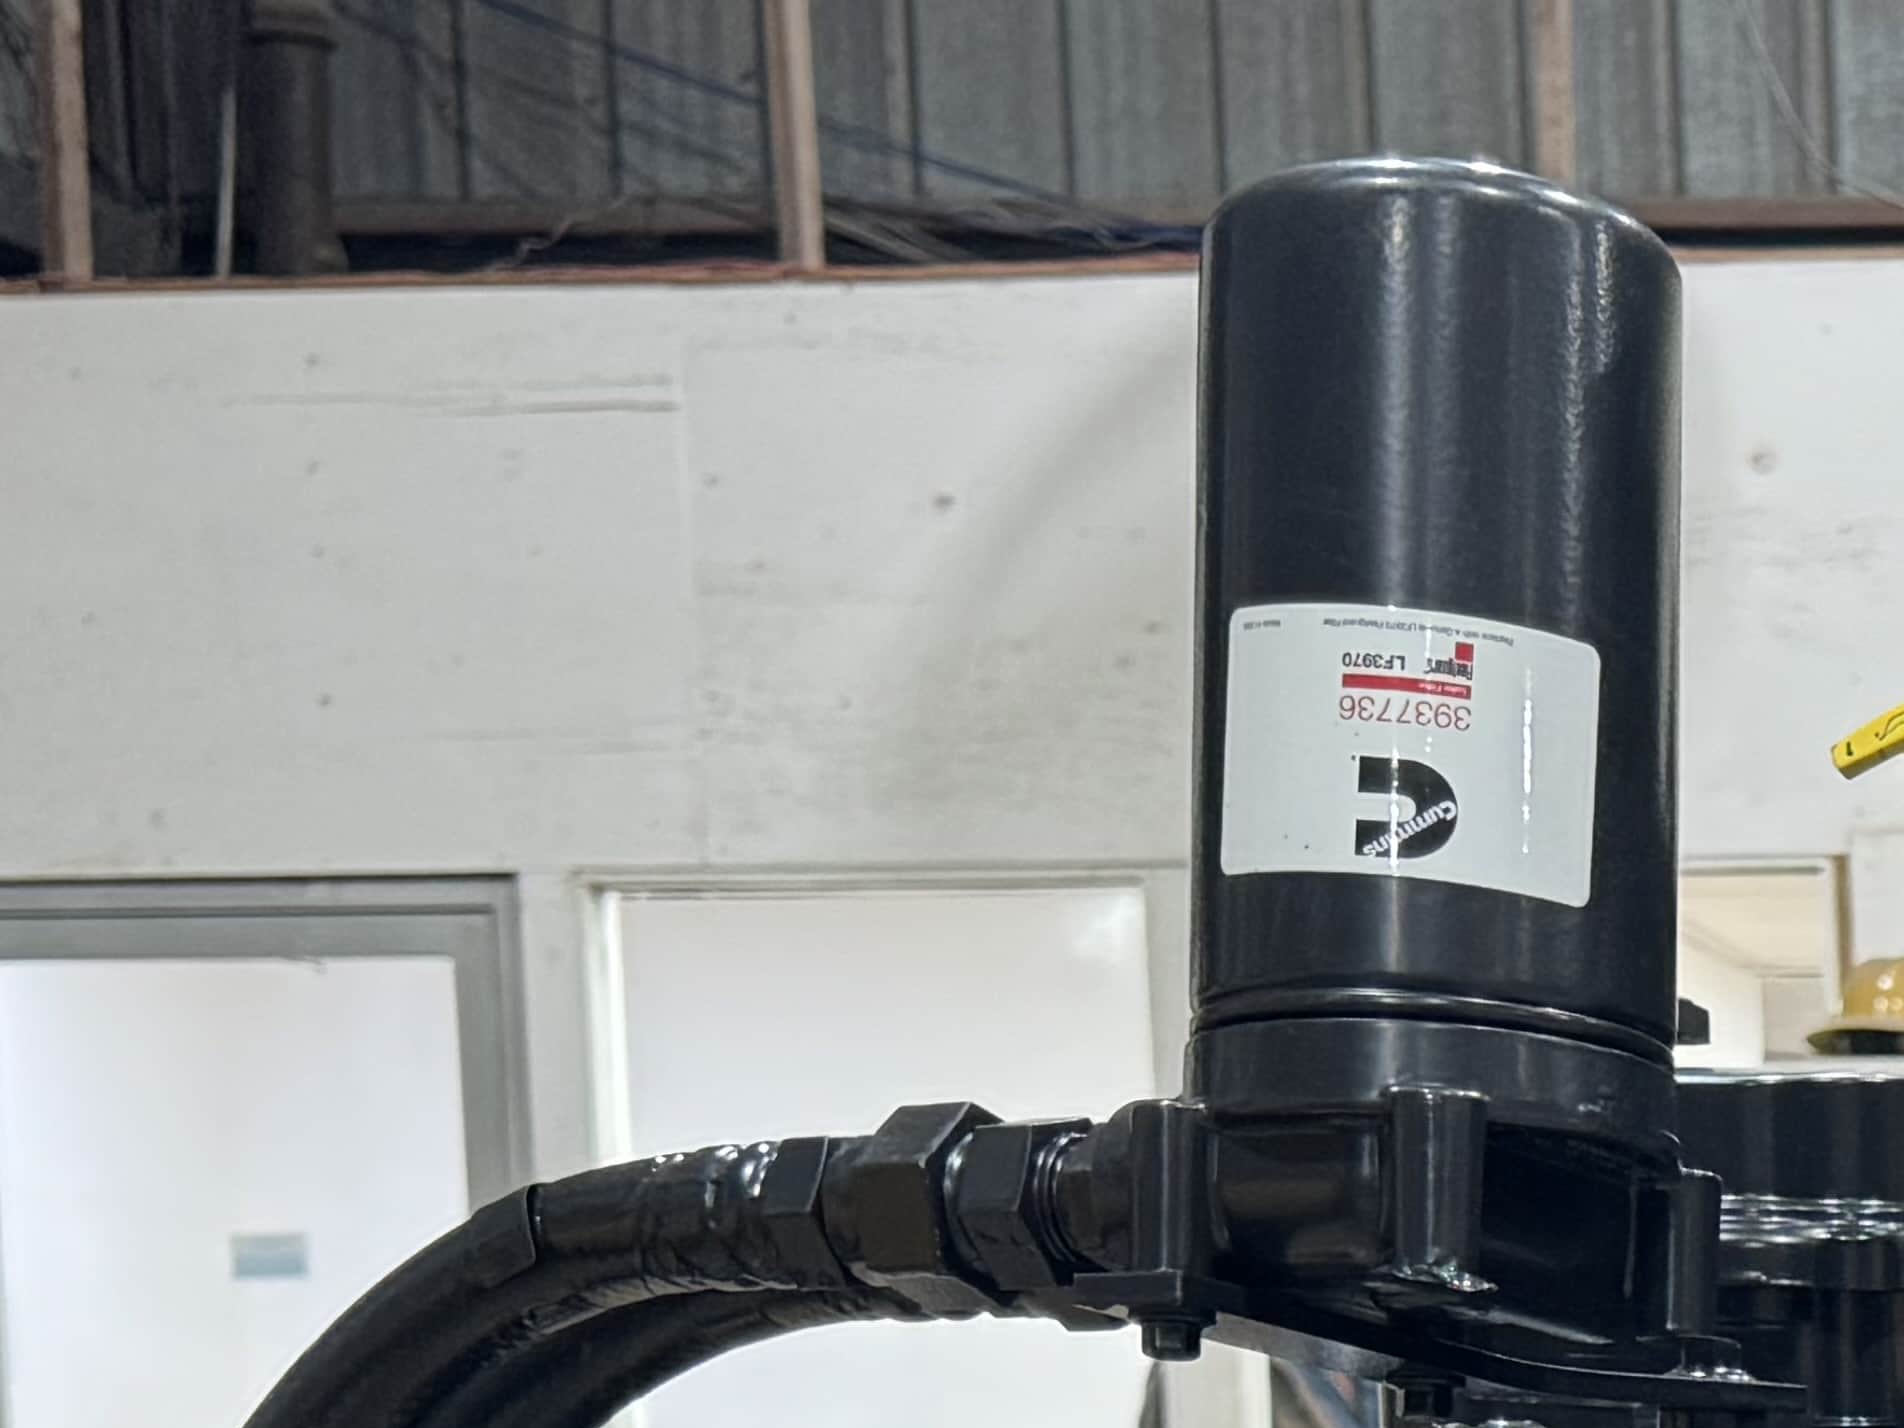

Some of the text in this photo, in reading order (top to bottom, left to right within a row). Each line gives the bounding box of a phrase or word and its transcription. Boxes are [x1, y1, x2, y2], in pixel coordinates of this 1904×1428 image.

[1342, 653, 1406, 671] LF3970
[1339, 695, 1472, 731] 3937736
[1362, 799, 1457, 858] Cummins
